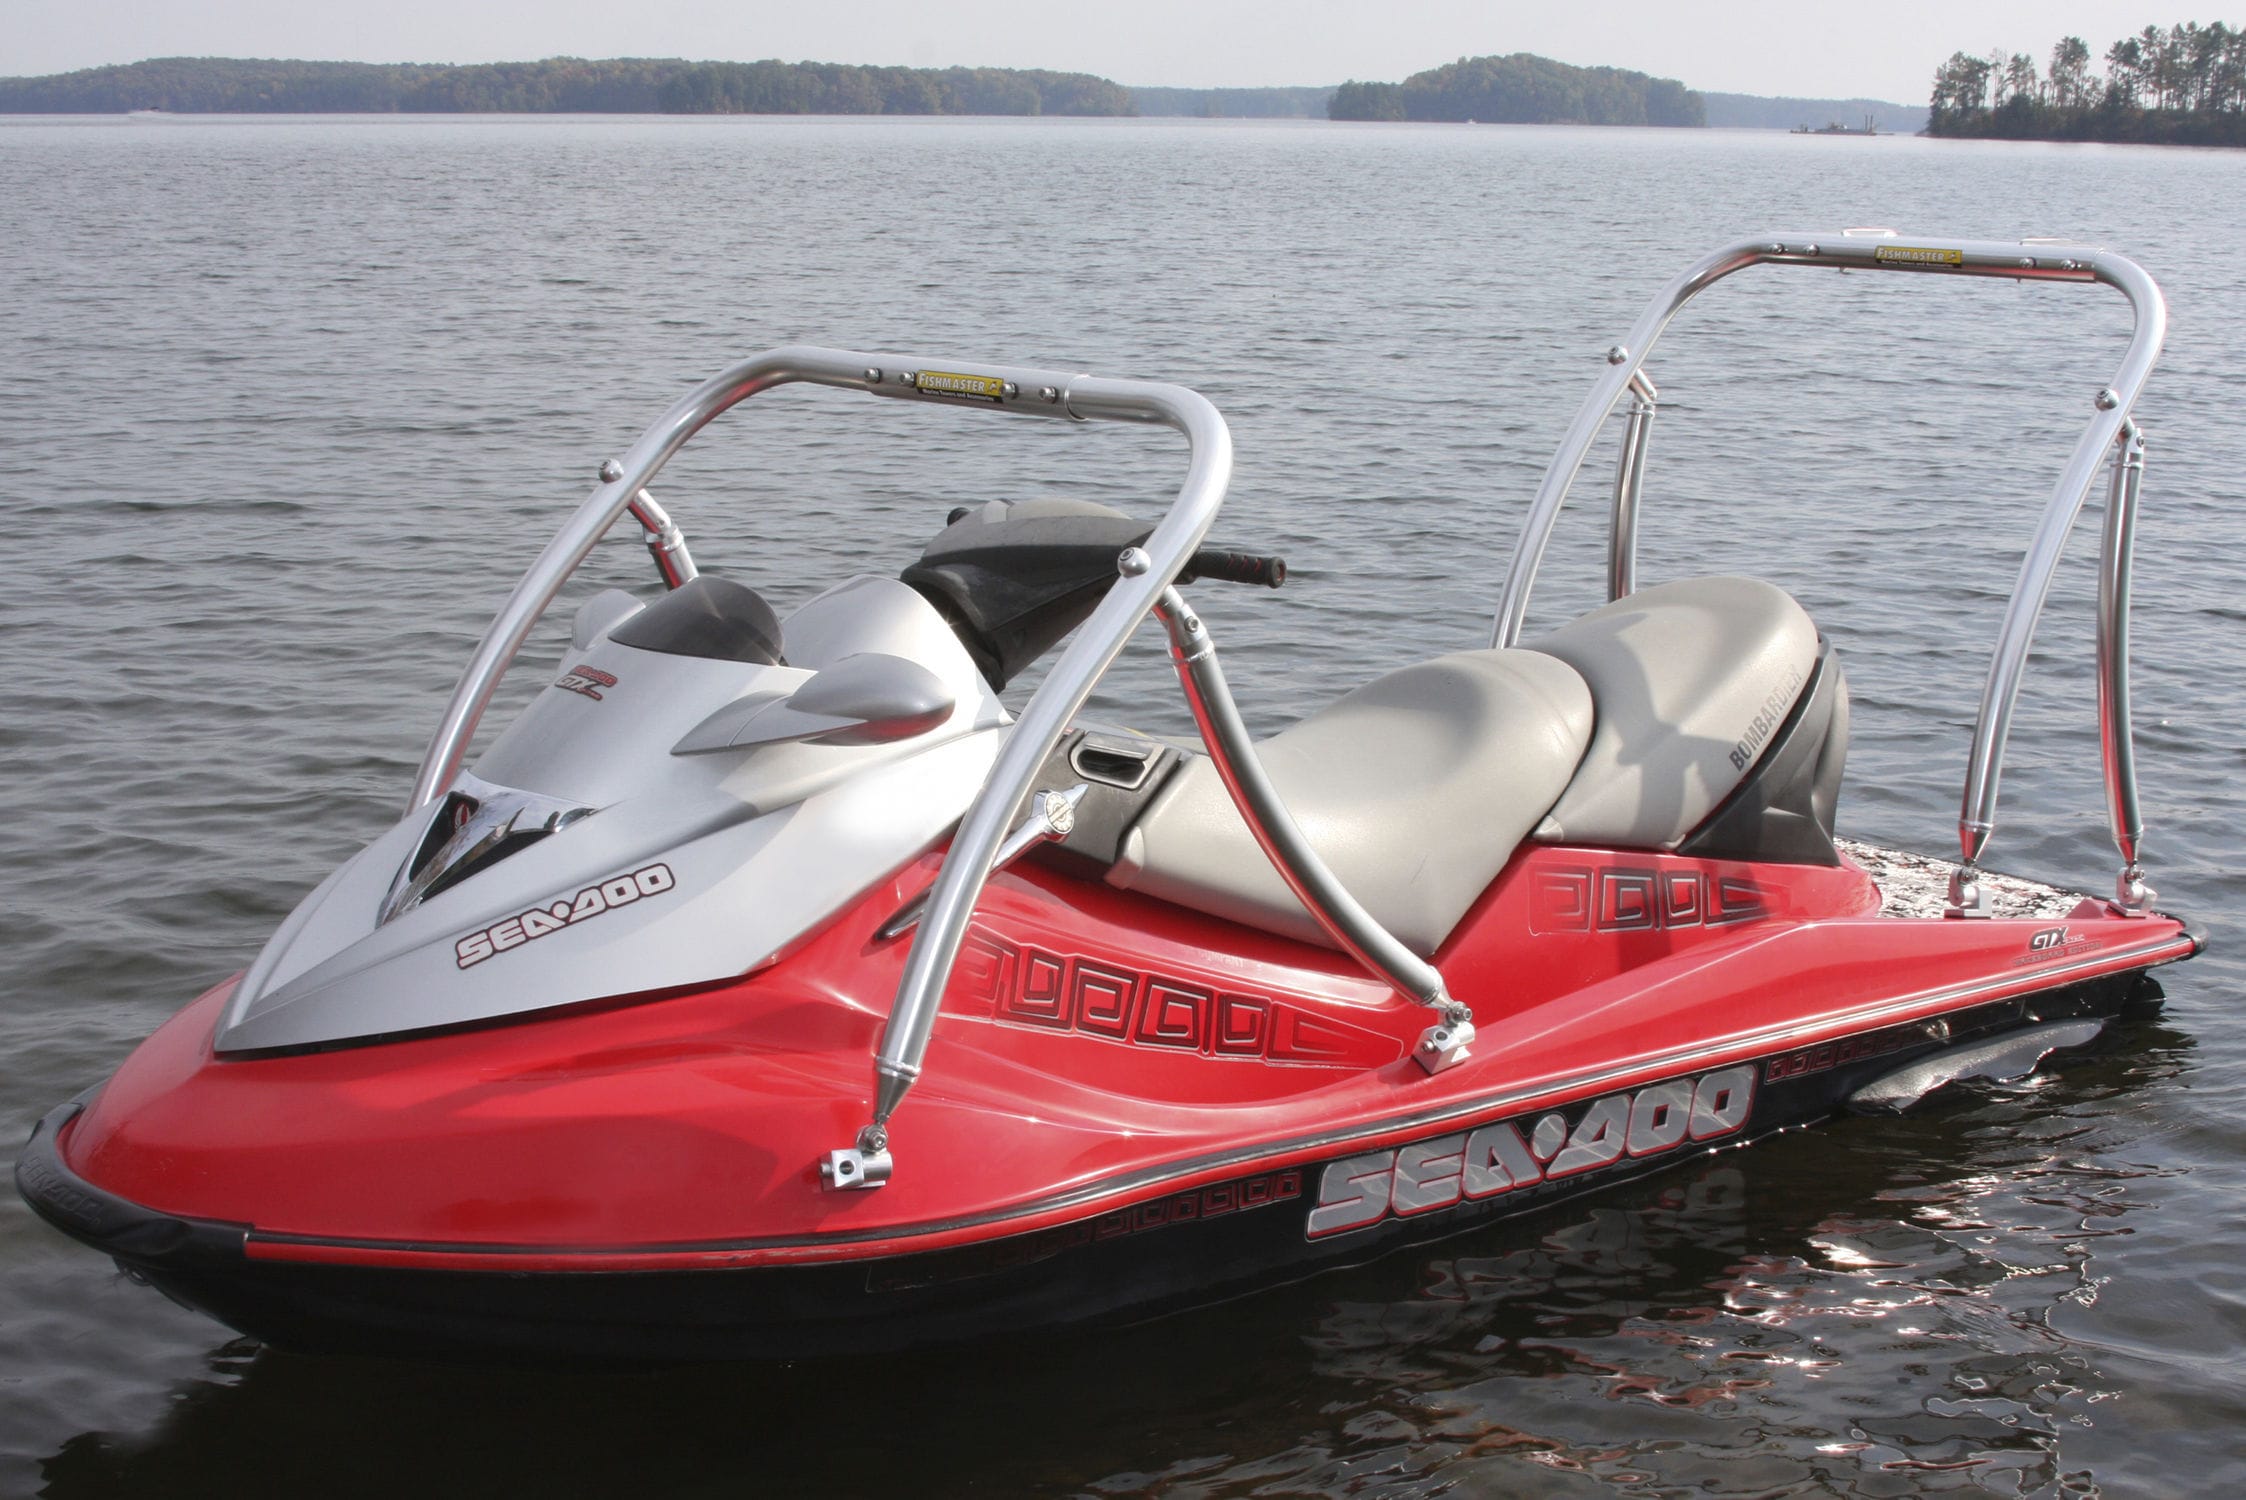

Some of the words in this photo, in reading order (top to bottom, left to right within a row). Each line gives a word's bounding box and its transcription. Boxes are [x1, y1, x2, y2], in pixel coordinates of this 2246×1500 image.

[1877, 247, 1944, 261] FISHMASTER
[918, 372, 985, 392] FISHMASTER
[2030, 926, 2069, 951] GTX
